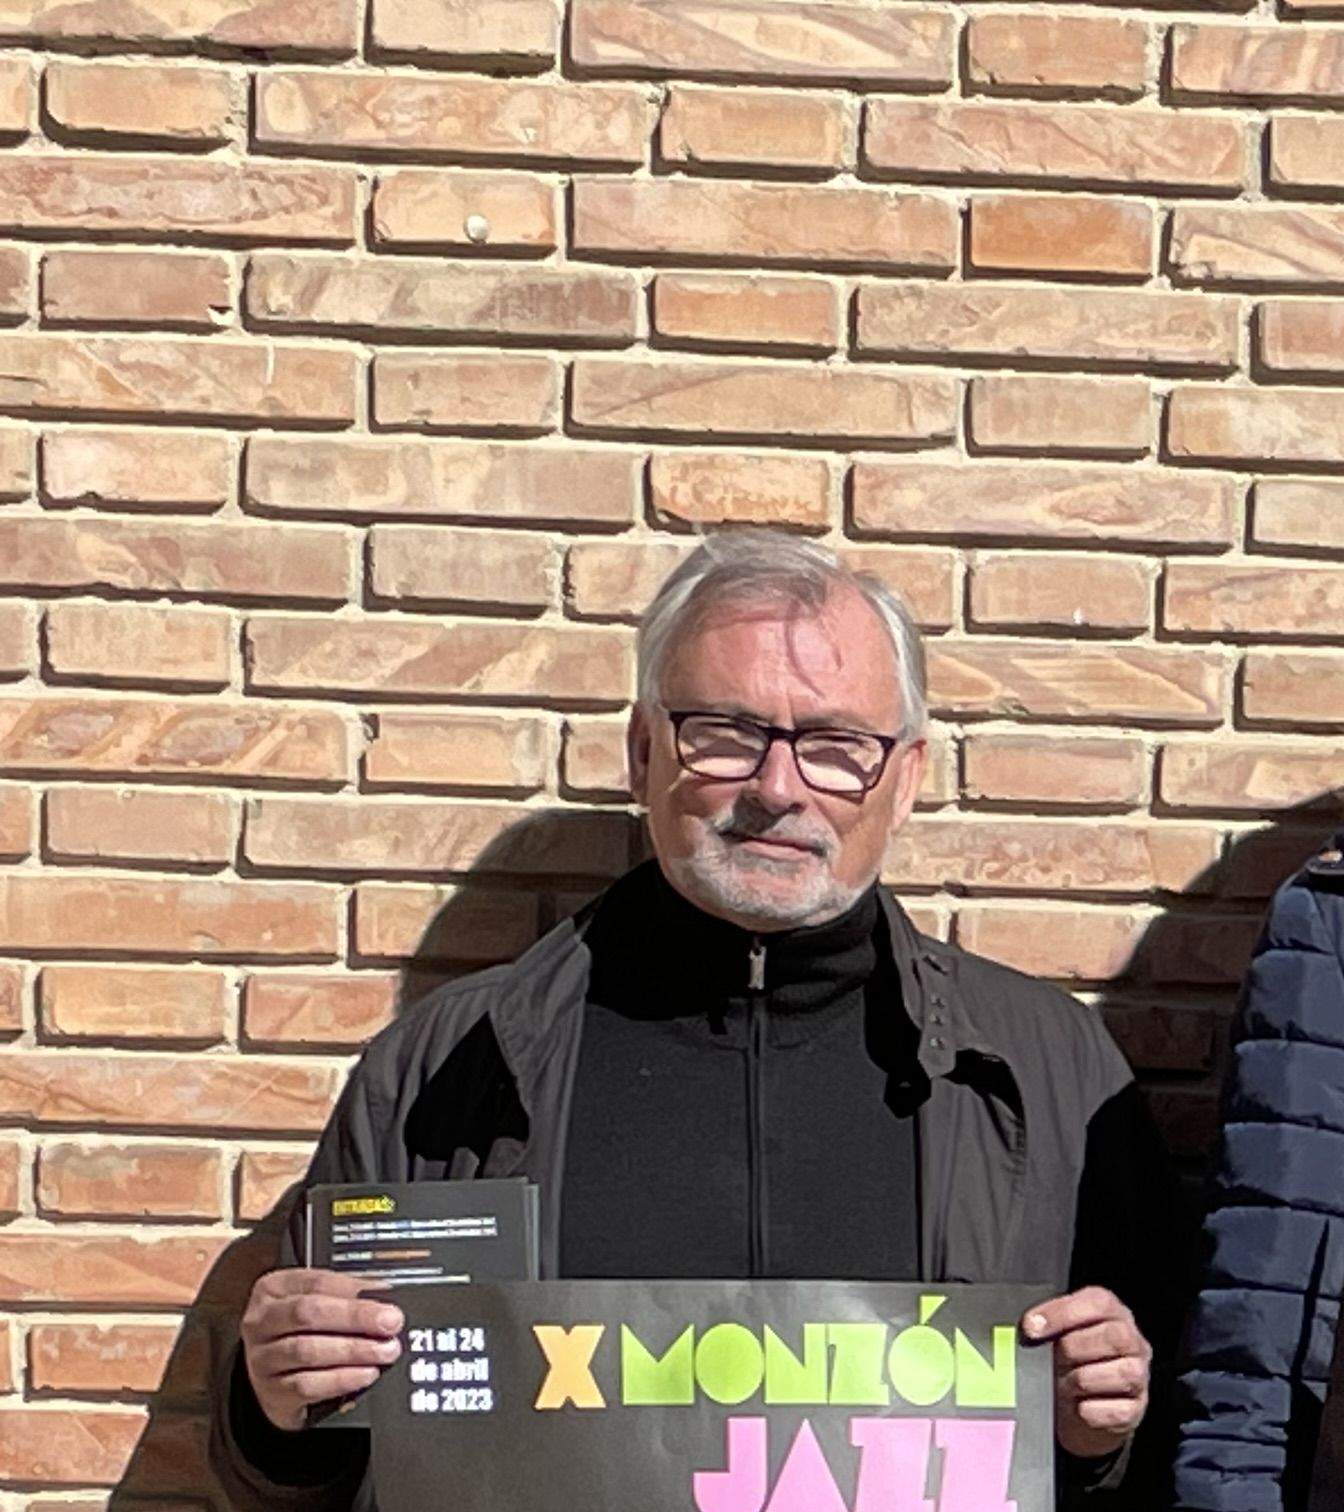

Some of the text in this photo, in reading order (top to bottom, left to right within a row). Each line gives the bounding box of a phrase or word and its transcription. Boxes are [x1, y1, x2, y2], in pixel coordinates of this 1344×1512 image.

[409, 1328, 485, 1351] 21 al 24
[533, 1294, 1017, 1410] X MONZÓN
[411, 1358, 489, 1382] de abril
[411, 1388, 493, 1412] de 2023
